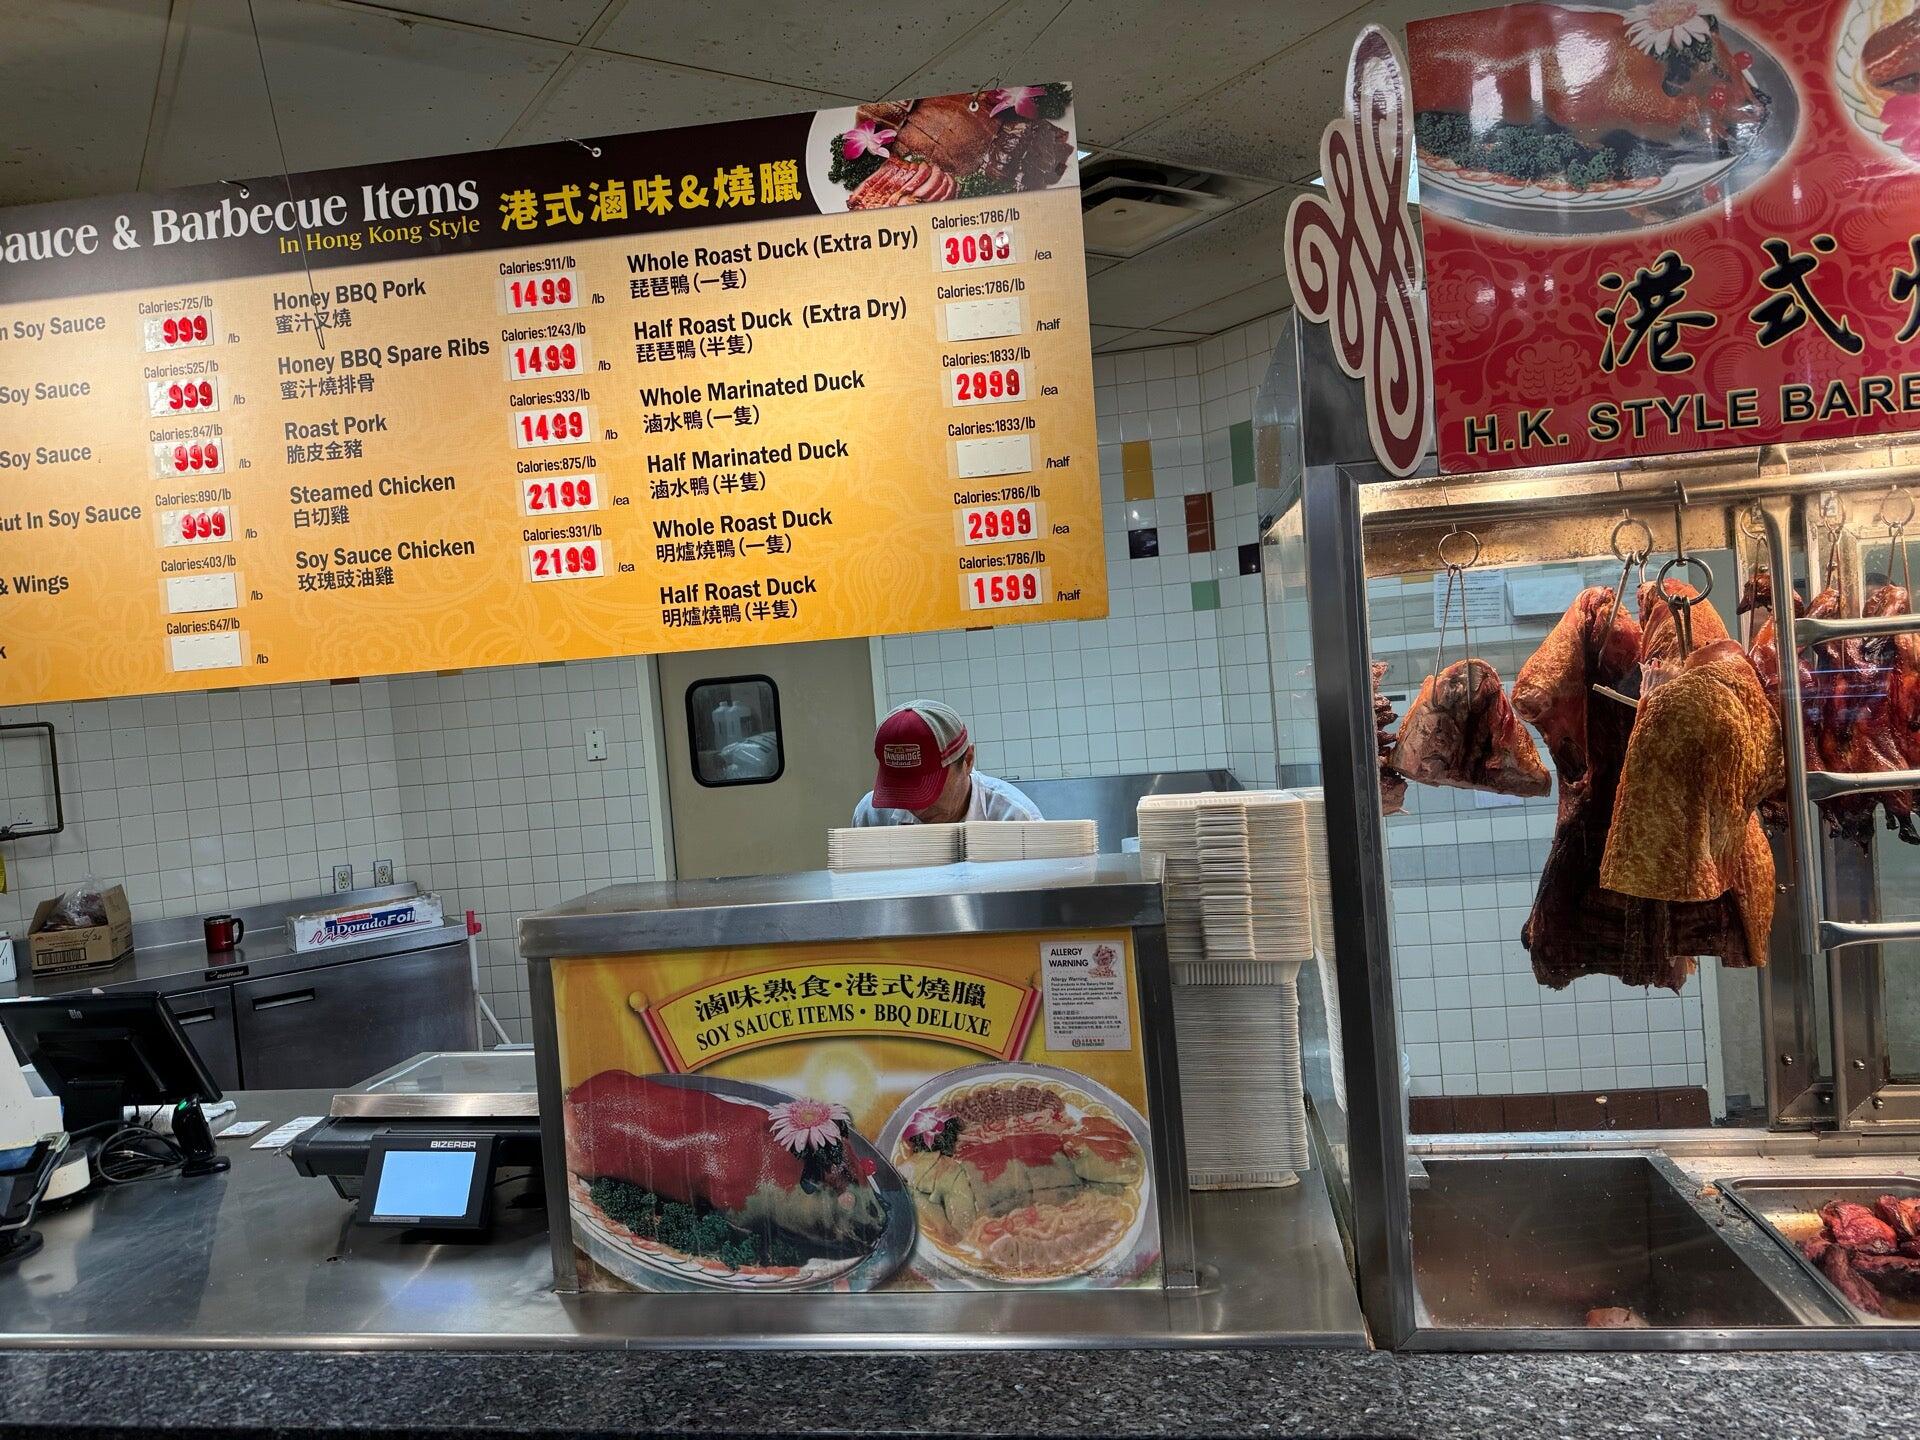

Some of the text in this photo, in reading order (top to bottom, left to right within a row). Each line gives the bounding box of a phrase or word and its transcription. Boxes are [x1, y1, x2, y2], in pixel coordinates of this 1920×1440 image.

[0, 179, 480, 263] auce & Barbecue Items
[931, 208, 1020, 230] Calories:1786/lb
[279, 216, 480, 254] In Hong Kong Style
[627, 226, 918, 273] Whole Roast Duck (Extra Dry)
[499, 256, 576, 276] Calories:911/lb
[273, 278, 427, 311] Honey BBQ Pork
[510, 277, 572, 308] 1499
[937, 278, 1025, 300] Calories:1786/lb
[138, 295, 213, 314] Calories:725/lb
[1595, 232, 1920, 374] 港式
[14, 321, 45, 341] Soy
[50, 316, 106, 334] Sauce
[163, 315, 208, 344] 999
[275, 309, 352, 334] 蜜汁叉燒
[634, 296, 907, 341] Half Roast Duck (Extra Dry)
[501, 324, 586, 342] Calories:1243/lb
[144, 360, 219, 378] Calories:525/lb
[278, 337, 490, 375] Honey BBQ Spare Ribs
[514, 343, 577, 375] 1499
[942, 347, 1031, 368] Calories:1833/lb
[0, 381, 91, 406] Soy Sauce
[168, 381, 213, 410] 999
[280, 373, 375, 400] 蜜汁燒排骨
[510, 388, 590, 407] Calories:933/lb
[640, 370, 865, 407] Whole Marinated Duck
[956, 368, 1021, 401] 2999
[149, 424, 223, 442] Calories:847/lb
[284, 414, 388, 440] Roast Pork
[521, 411, 583, 442] 1499
[947, 416, 1036, 437] Calories:1833/lb
[1465, 408, 1569, 455] H.K.
[1589, 387, 1759, 442] STYLE
[0, 446, 92, 470] Soy Sauce
[174, 443, 219, 472] 999
[287, 438, 363, 465] 脆皮金豬
[517, 456, 597, 474] Calories:875/lb
[647, 439, 849, 474] Half Marinated Duck
[155, 488, 232, 507] Calories:890/lb
[290, 475, 455, 505] Steamed Chicken
[528, 479, 592, 510] 2199
[953, 485, 1041, 505] Calories:1786/lb
[27, 512, 43, 529] In
[48, 509, 80, 530] Soy
[85, 505, 141, 524] Sauce
[181, 511, 226, 540] 999
[294, 505, 350, 528] 白切雞
[653, 507, 833, 539] Whole Roast Duck
[968, 507, 1031, 540] 2999
[523, 524, 602, 542] Calories:931/lb
[161, 554, 236, 572] Calories:403/lb
[296, 539, 475, 570] Soy Sauce Chicken
[533, 545, 597, 576] 2199
[959, 552, 1046, 570] Calories:1786/lb
[13, 574, 69, 595] Wings
[660, 575, 817, 605] Half Roast Duck
[973, 573, 1037, 604] 1599
[166, 618, 240, 635] Calories:647/lb
[337, 918, 386, 934] Dorado
[387, 910, 416, 925] Foil
[1048, 959, 1089, 967] WARNING
[1050, 948, 1082, 956] ALLERGY
[696, 1003, 992, 1051] SOY SAUCE ITEMS BBQ DELUXE
